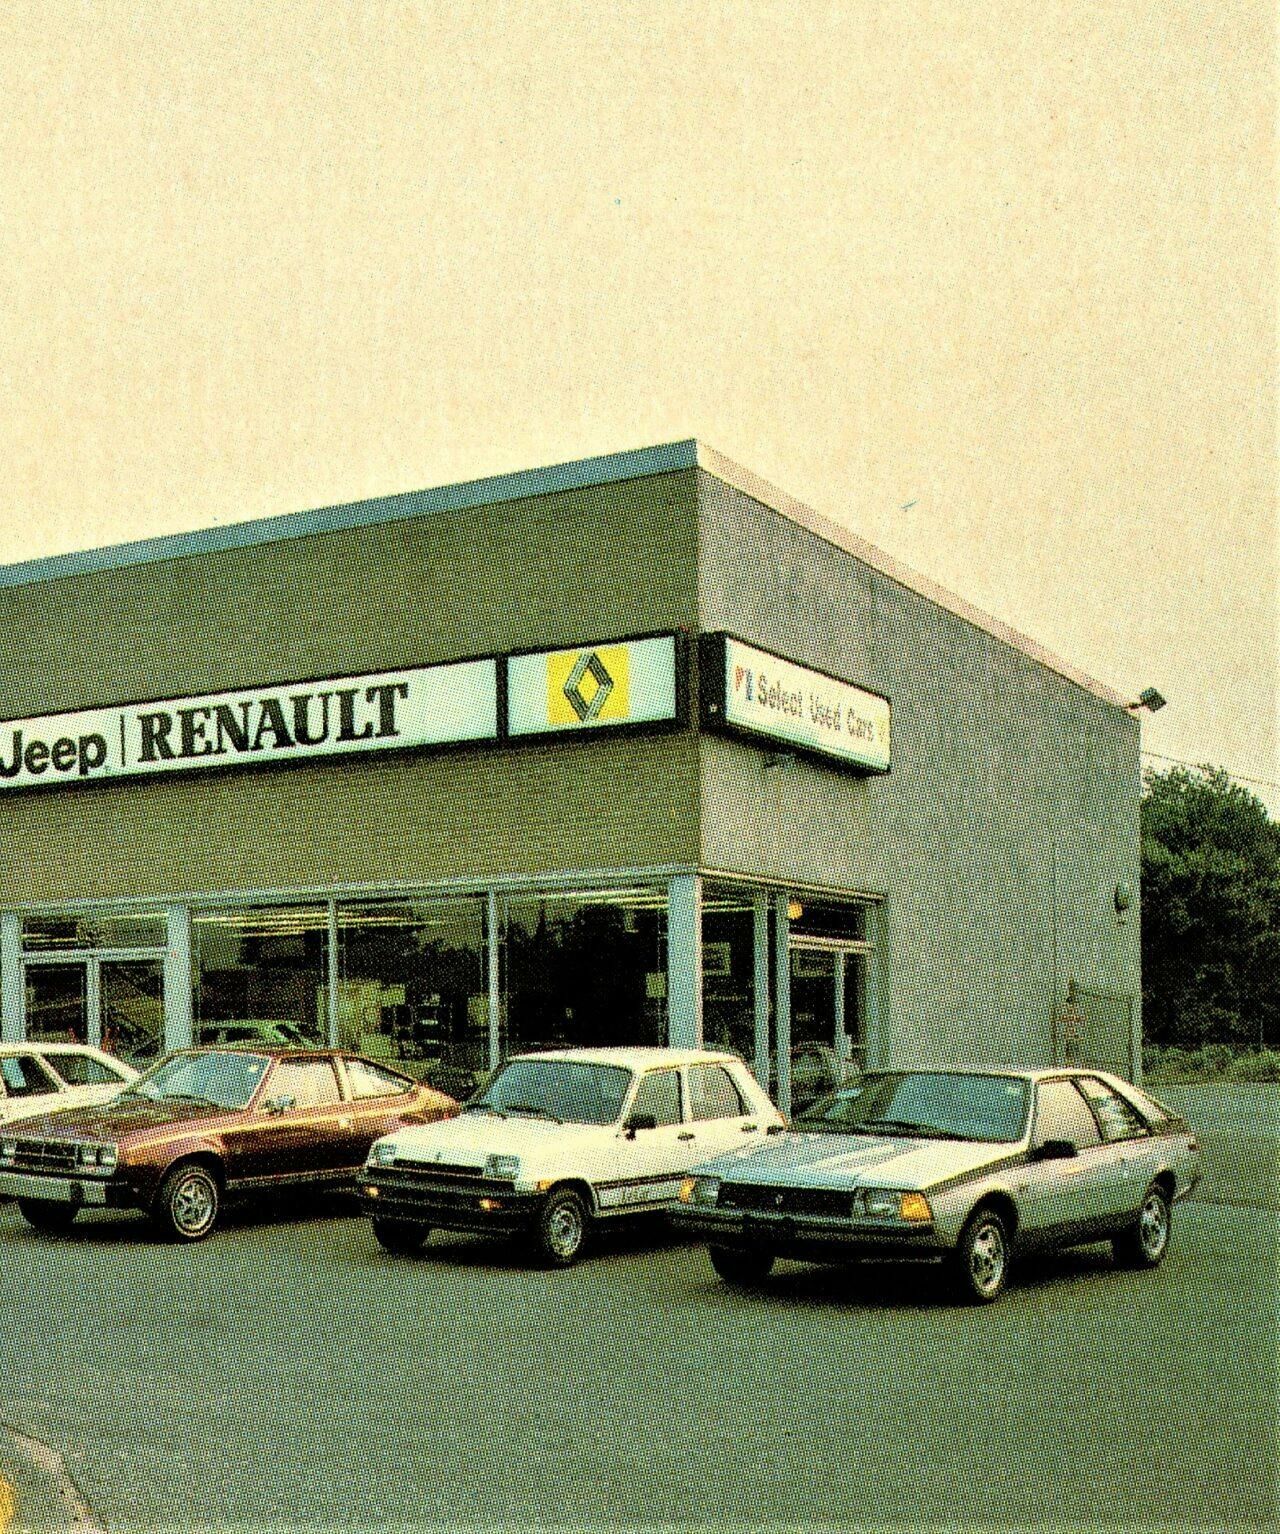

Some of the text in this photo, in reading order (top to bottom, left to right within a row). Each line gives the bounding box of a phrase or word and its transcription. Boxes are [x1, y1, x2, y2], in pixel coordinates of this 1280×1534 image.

[137, 682, 408, 763] RENAULT
[758, 674, 874, 743] Select Used Cars
